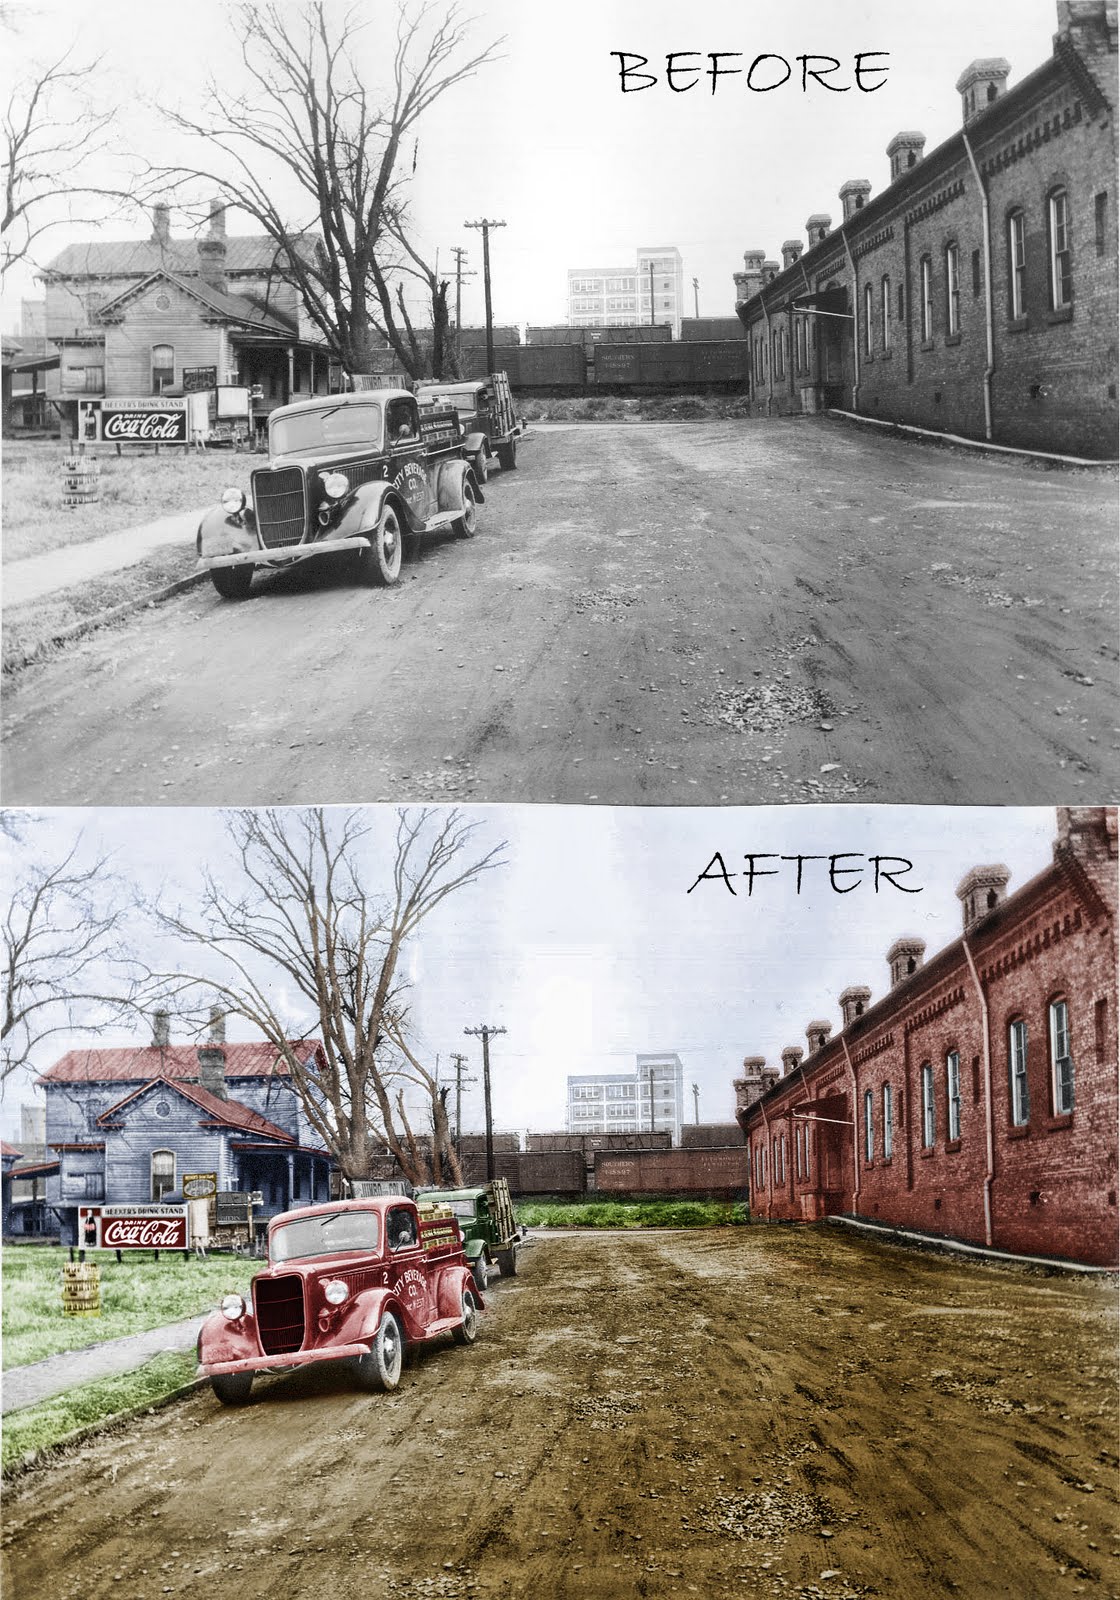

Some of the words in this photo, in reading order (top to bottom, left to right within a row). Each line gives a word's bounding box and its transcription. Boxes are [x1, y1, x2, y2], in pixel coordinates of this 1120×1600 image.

[138, 401, 159, 409] DRINK
[104, 413, 183, 439] Coca-Cola
[382, 464, 389, 478] 2
[138, 1206, 159, 1215] DRINK
[161, 1206, 184, 1215] STAND
[104, 1220, 183, 1245] Coca-Cola
[382, 1271, 389, 1285] 2
